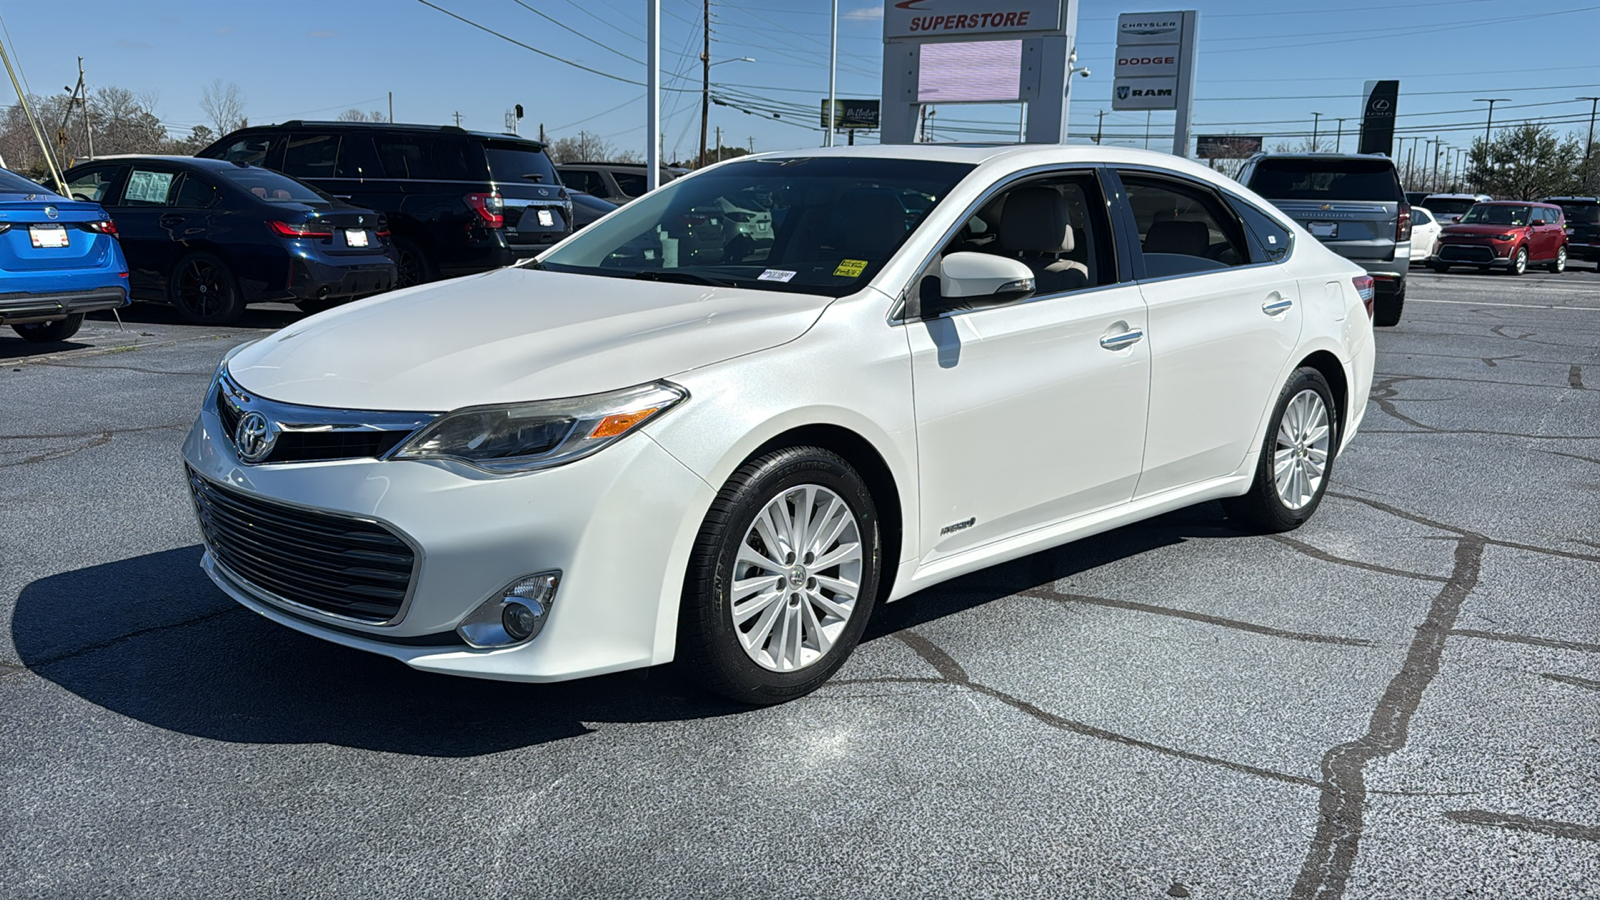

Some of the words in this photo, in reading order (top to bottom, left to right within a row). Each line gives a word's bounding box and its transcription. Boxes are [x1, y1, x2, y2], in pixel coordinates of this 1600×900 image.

[909, 11, 1031, 32] SUPERSTORE
[1121, 21, 1176, 29] CHRYSLER
[1118, 56, 1175, 66] DODGE
[1131, 88, 1173, 97] RAM
